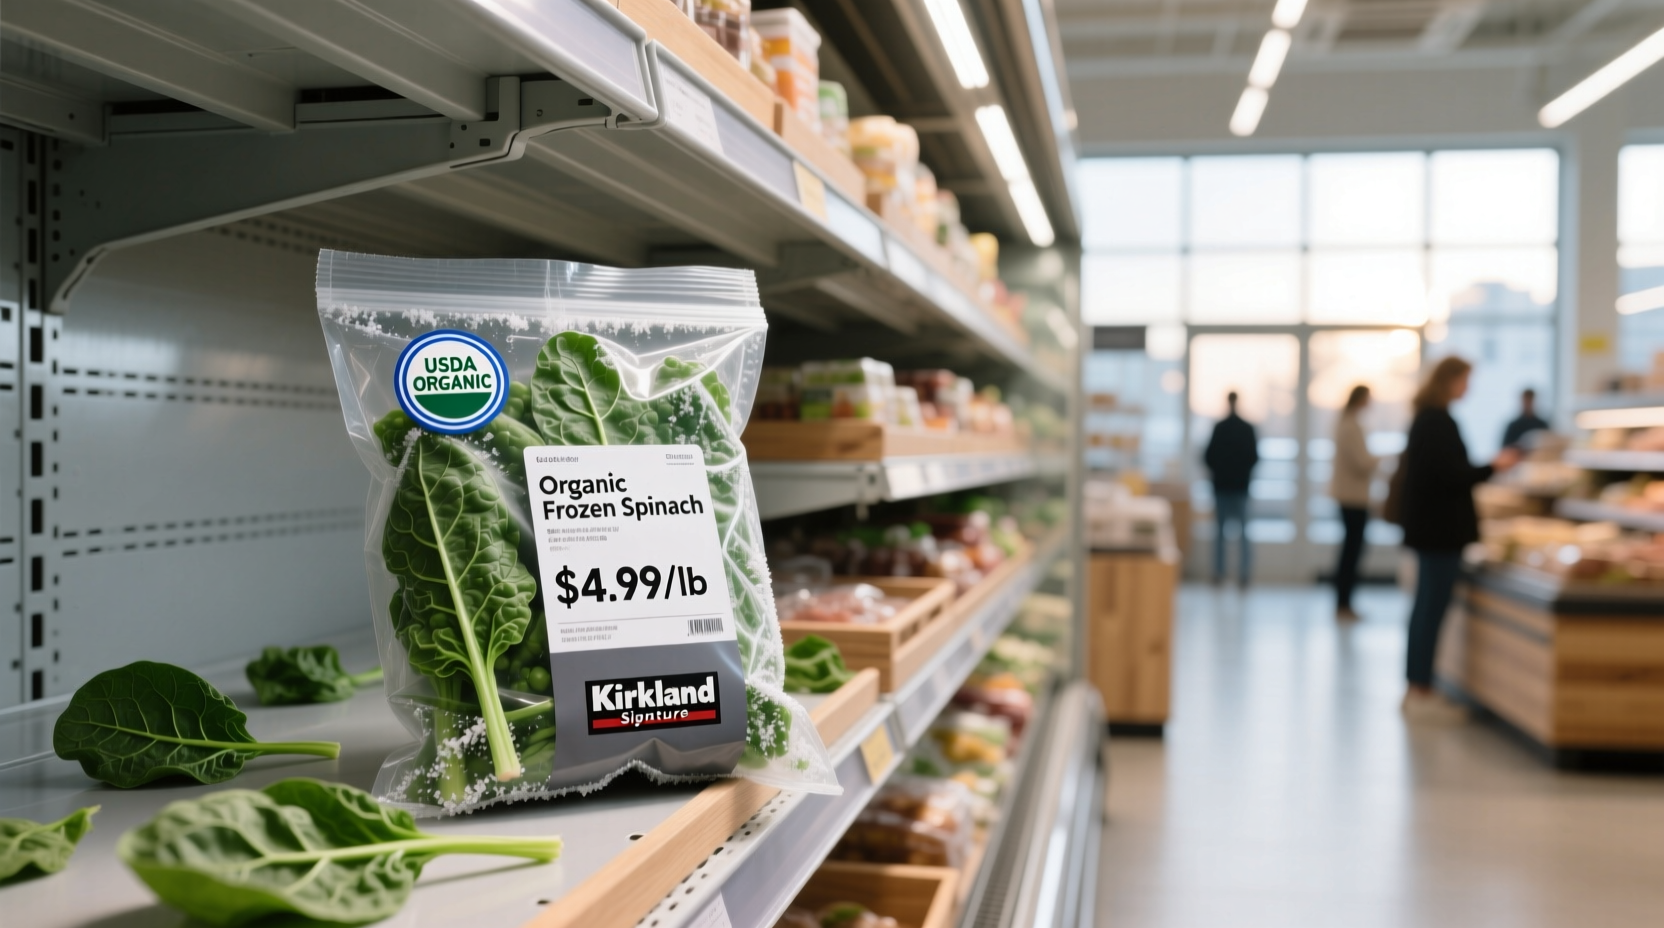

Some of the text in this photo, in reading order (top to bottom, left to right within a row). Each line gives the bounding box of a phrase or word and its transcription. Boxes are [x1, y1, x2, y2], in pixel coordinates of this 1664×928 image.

[424, 356, 477, 373] USDA
[413, 374, 492, 391] ORGANIC
[539, 472, 627, 500] Organic
[543, 494, 704, 521] Frozen Spinach
[555, 564, 708, 609] $4.99/lb
[592, 675, 715, 712] Kirkland
